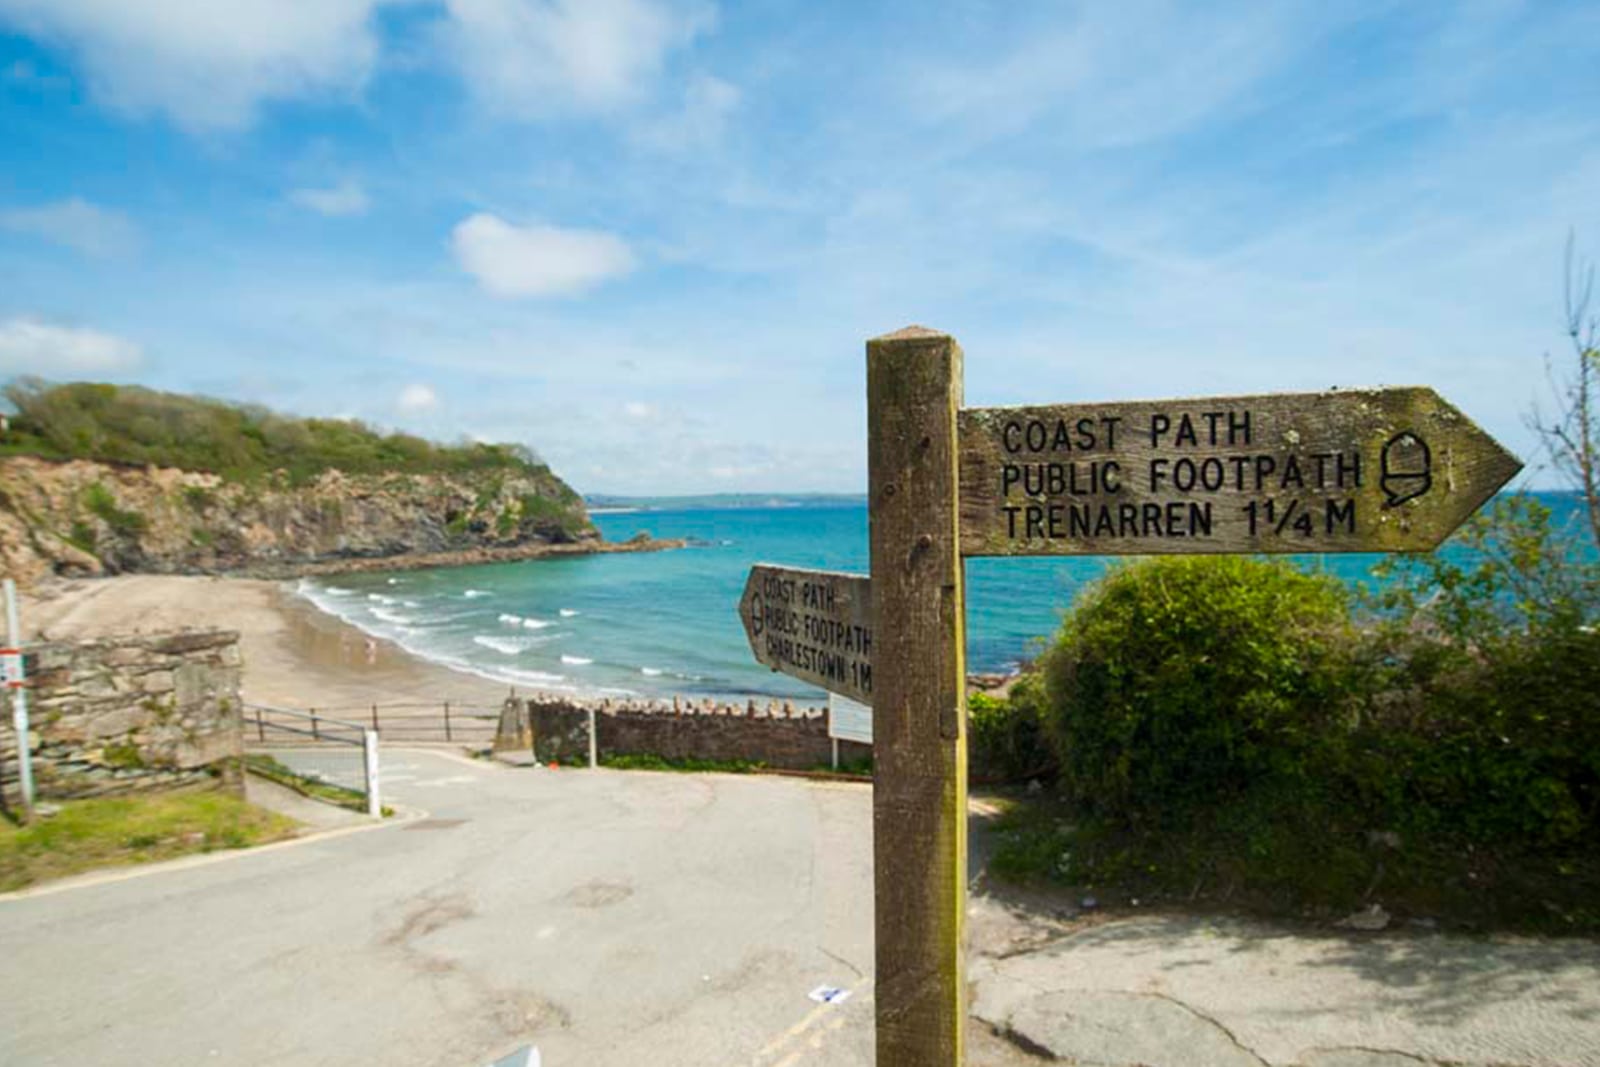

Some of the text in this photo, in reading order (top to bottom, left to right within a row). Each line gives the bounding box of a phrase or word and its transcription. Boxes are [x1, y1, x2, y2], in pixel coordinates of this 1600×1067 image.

[1003, 411, 1250, 453] COAST PATH
[1003, 453, 1362, 496] PUBLIC FOOTPATH
[1002, 503, 1212, 539] TRENARREN
[763, 576, 836, 612] COAST PATH
[765, 605, 872, 656] PUBLIC FOOTPATH
[766, 633, 846, 684] CHARLESTOWN
